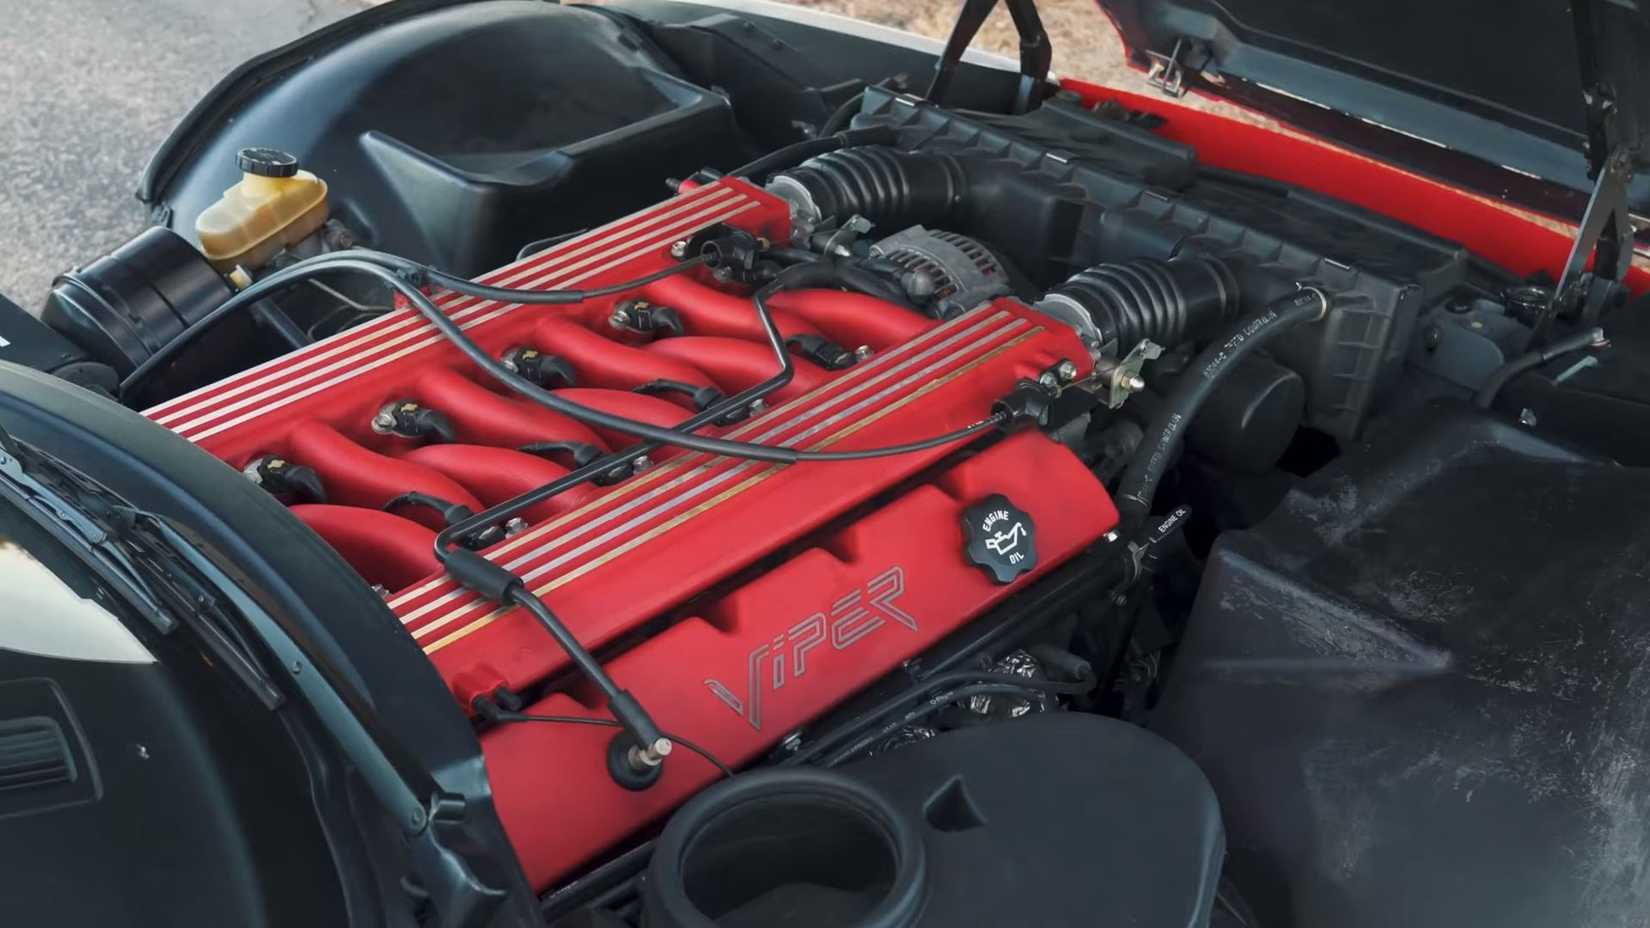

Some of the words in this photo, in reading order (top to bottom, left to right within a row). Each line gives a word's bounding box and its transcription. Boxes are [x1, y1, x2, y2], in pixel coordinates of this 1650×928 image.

[982, 509, 1009, 532] ENGINE
[1158, 515, 1178, 533] ENGINE
[1009, 552, 1024, 564] OIL
